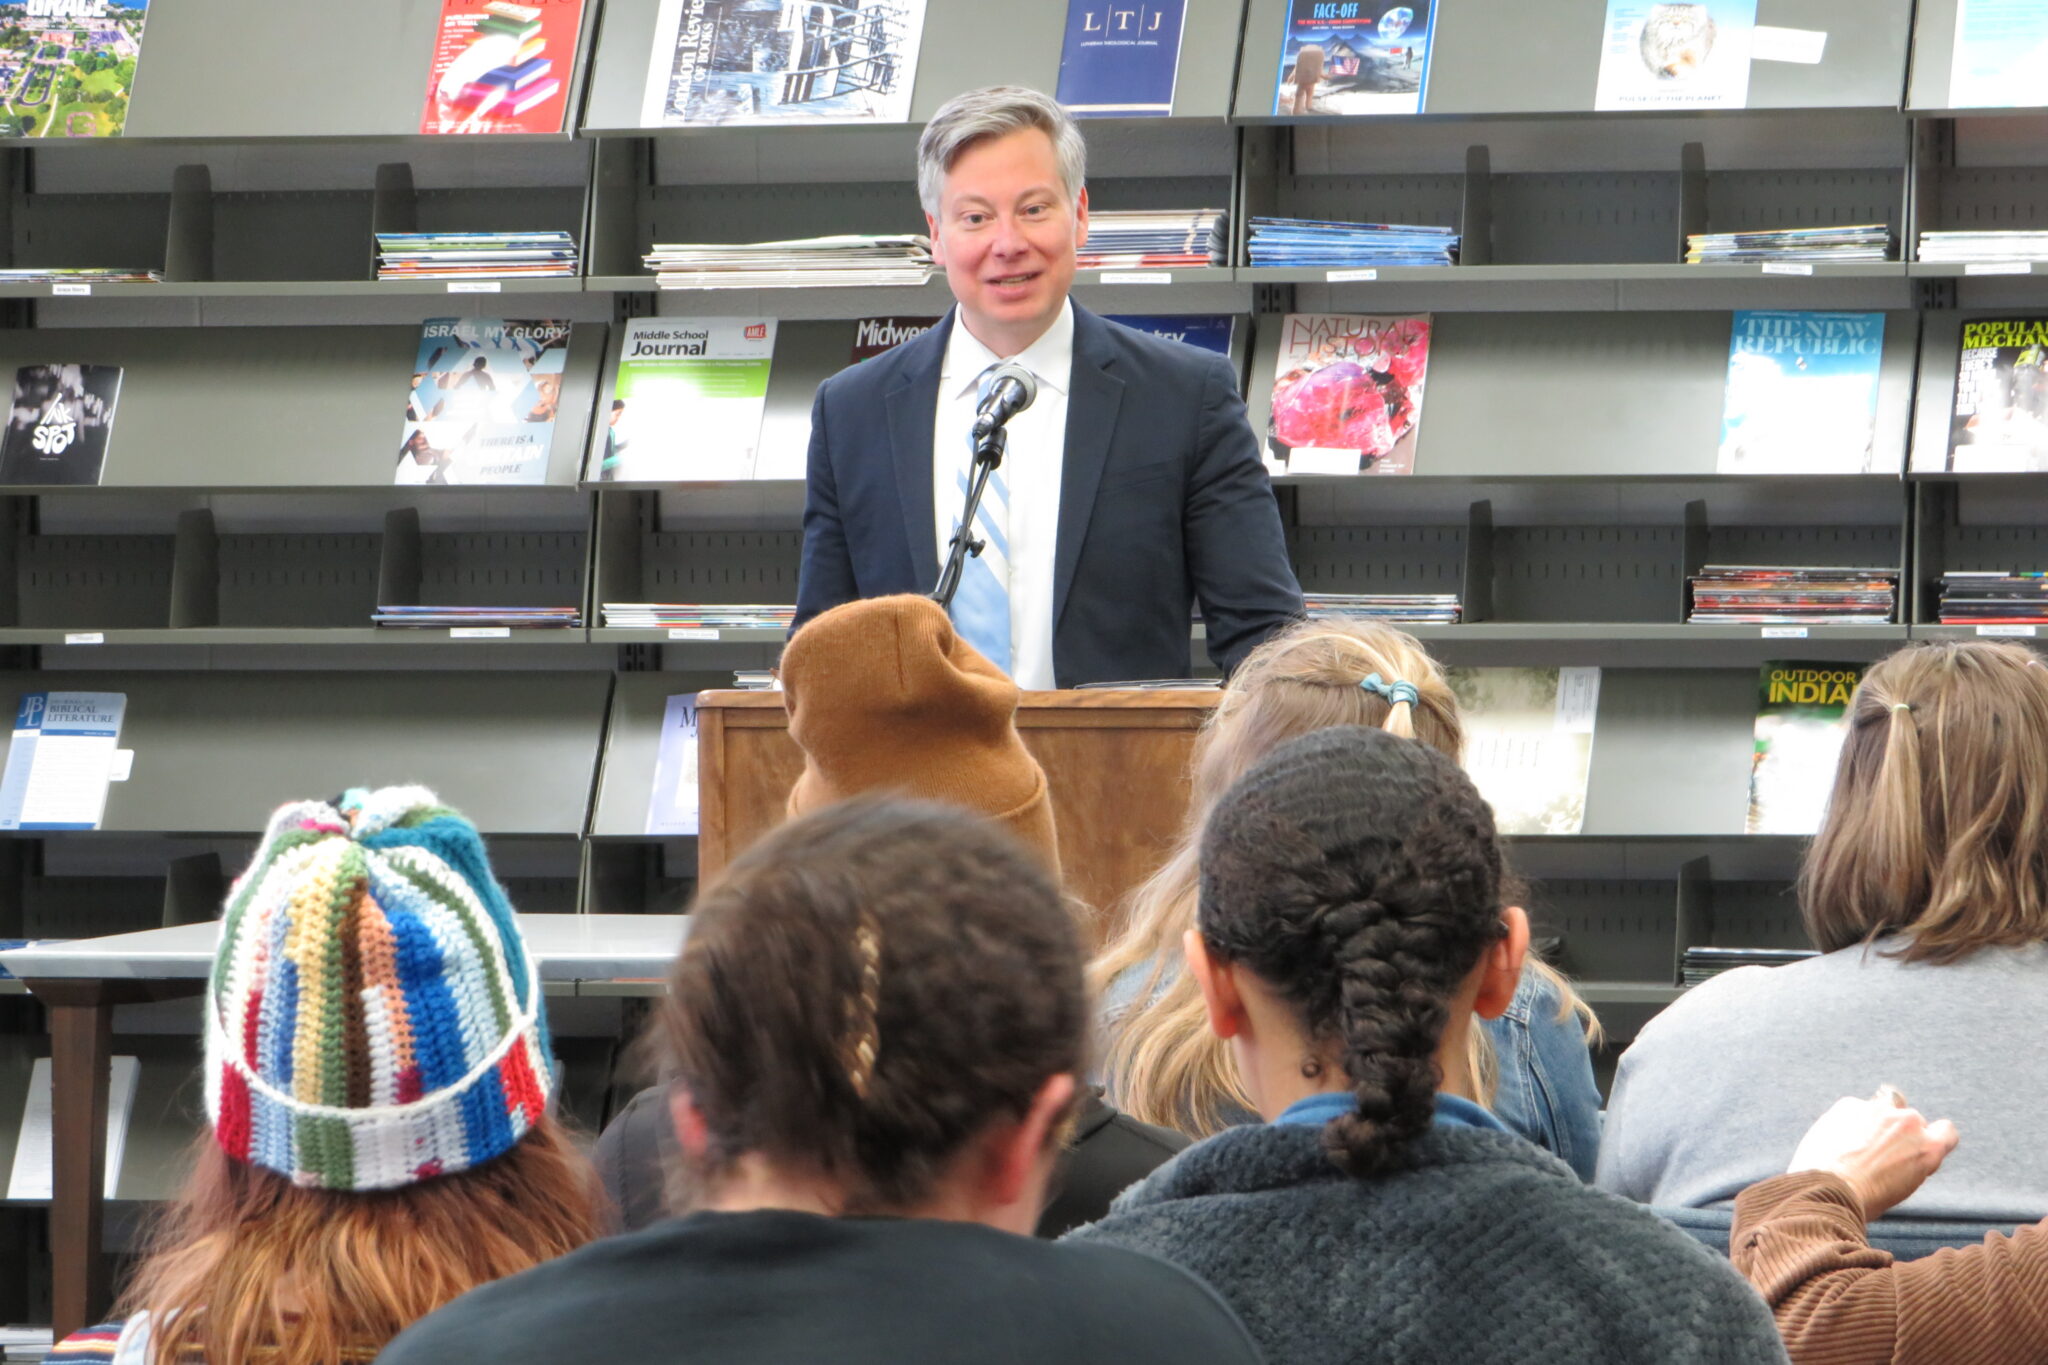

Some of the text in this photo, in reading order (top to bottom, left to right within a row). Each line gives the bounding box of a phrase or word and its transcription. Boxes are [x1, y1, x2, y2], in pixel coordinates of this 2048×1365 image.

[1313, 3, 1359, 18] FACE-OFF
[1083, 11, 1162, 31] L T J
[697, 22, 714, 64] BOOKS
[664, 52, 697, 121] London
[424, 325, 568, 339] ISRAEL MY GLORY
[745, 326, 765, 338] AMLE
[1292, 317, 1418, 338] NATURAL
[1741, 318, 1872, 338] THE NEW
[633, 331, 709, 340] Middle School
[630, 341, 708, 356] Journal
[1735, 335, 1878, 354] REPUBLIC
[32, 422, 76, 454] SPOT
[480, 464, 522, 475] PEOPLE
[1770, 669, 1857, 683] OUTDOOR
[1769, 682, 1858, 704] INDIA
[49, 705, 96, 713] BIBLICAL
[47, 713, 114, 723] LITERATURE
